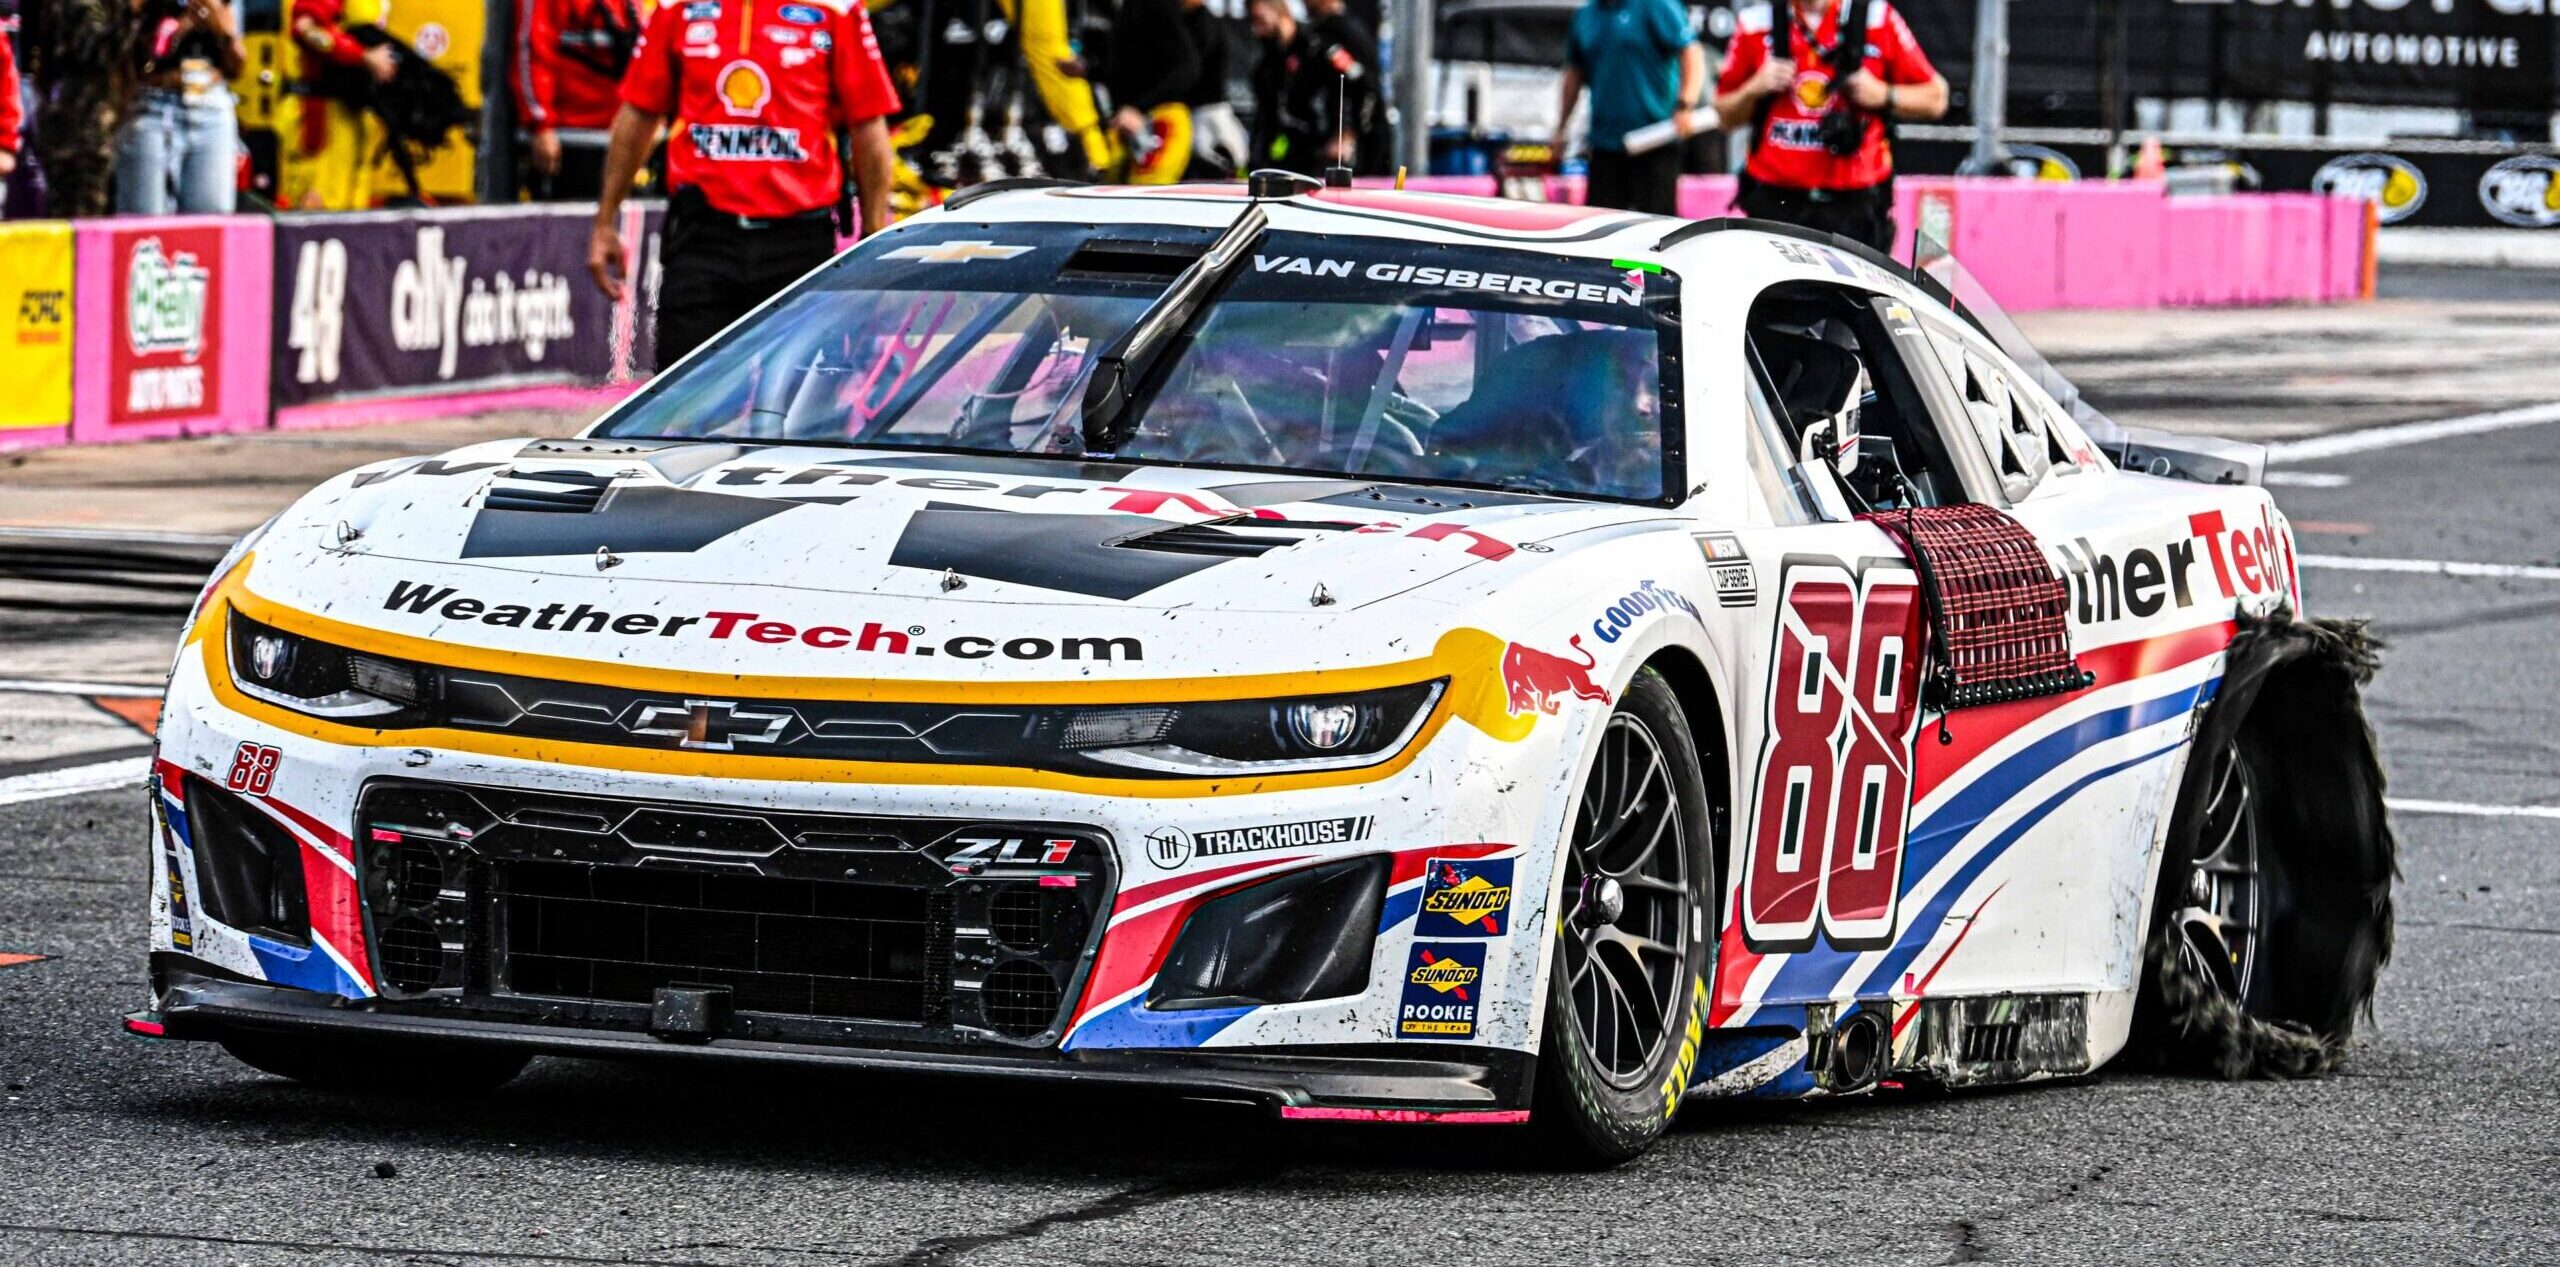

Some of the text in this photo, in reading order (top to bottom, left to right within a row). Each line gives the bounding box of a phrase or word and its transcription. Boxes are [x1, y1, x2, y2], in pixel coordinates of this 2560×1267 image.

[2305, 30, 2519, 68] AUTOMOTIVE
[1253, 254, 1643, 307] VAN GISBERGEN
[288, 238, 347, 383] 48
[391, 226, 467, 380] ally
[1716, 567, 1750, 589] CUP SERIES
[2057, 503, 2285, 626] therTech
[225, 741, 282, 797] 88
[1744, 558, 1926, 950] 88
[944, 838, 1077, 864] ZL1
[1200, 819, 1347, 855] TRACKHOUSE
[1428, 888, 1508, 910] SUNOCO
[1413, 969, 1476, 983] SUNOCO
[1403, 1004, 1474, 1020] ROOKIE
[1421, 1023, 1438, 1031] THE
[1660, 972, 1709, 1120] EAGLE
